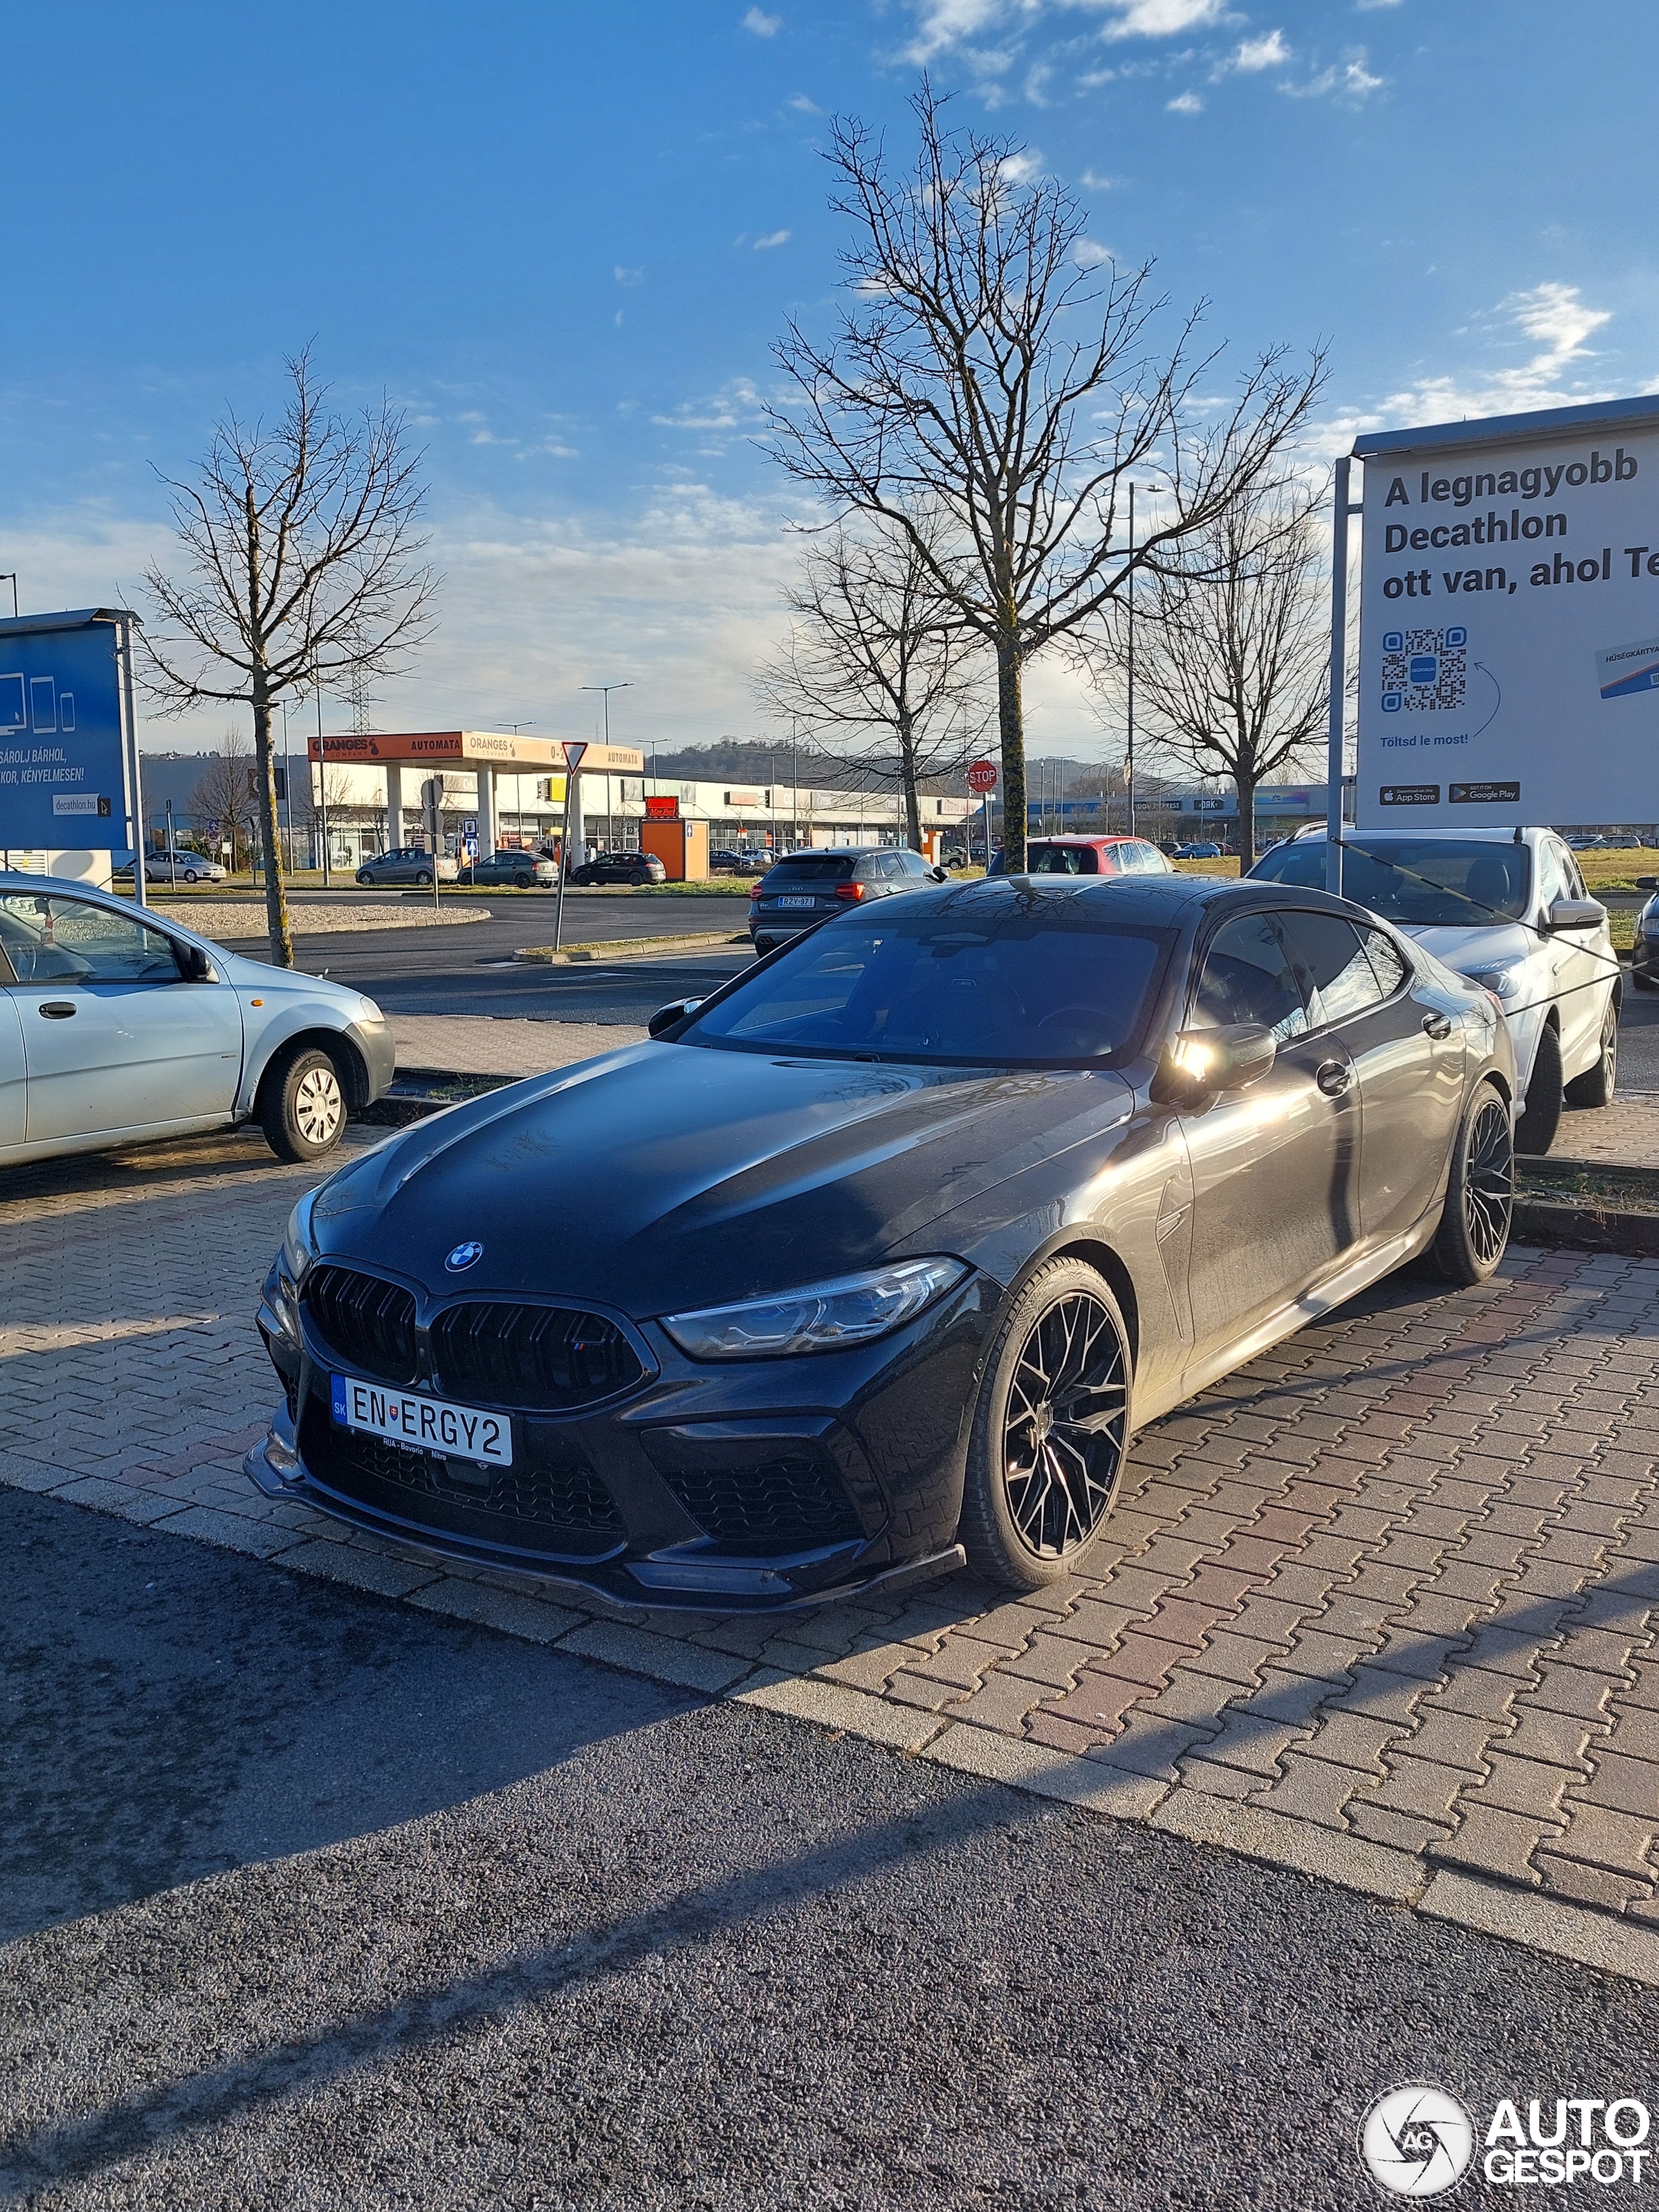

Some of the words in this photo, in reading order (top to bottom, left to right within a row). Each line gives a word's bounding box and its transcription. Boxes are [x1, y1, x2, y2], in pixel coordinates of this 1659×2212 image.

[1384, 477, 1410, 507] A
[1421, 448, 1638, 507] legnagyobb
[1385, 509, 1567, 553] Decathlon
[1383, 568, 1432, 599] ott
[1443, 565, 1517, 594] van,
[1529, 548, 1611, 586] ahol
[312, 738, 367, 751] ORANGES
[411, 739, 460, 751] AUTOMATA
[470, 737, 508, 751] ORANGES
[1380, 736, 1417, 747] Töltsd
[1421, 735, 1431, 745] le
[1434, 734, 1468, 745] most!
[32, 746, 67, 763] BÁRHOL,
[607, 752, 638, 765] AUTOMATA
[21, 767, 84, 784] KÉNYELMESEN!
[969, 769, 996, 784] STOP
[1396, 794, 1413, 802] App
[1470, 790, 1498, 800] Google
[1499, 789, 1516, 799] Play
[56, 798, 96, 810] decathlon.hu
[783, 898, 813, 906] RZY-971
[334, 1402, 346, 1416] SK
[353, 1386, 386, 1427] EN
[400, 1398, 502, 1456] ERGY2
[400, 1442, 424, 1455] Bavaria
[431, 1450, 447, 1461] Nitra
